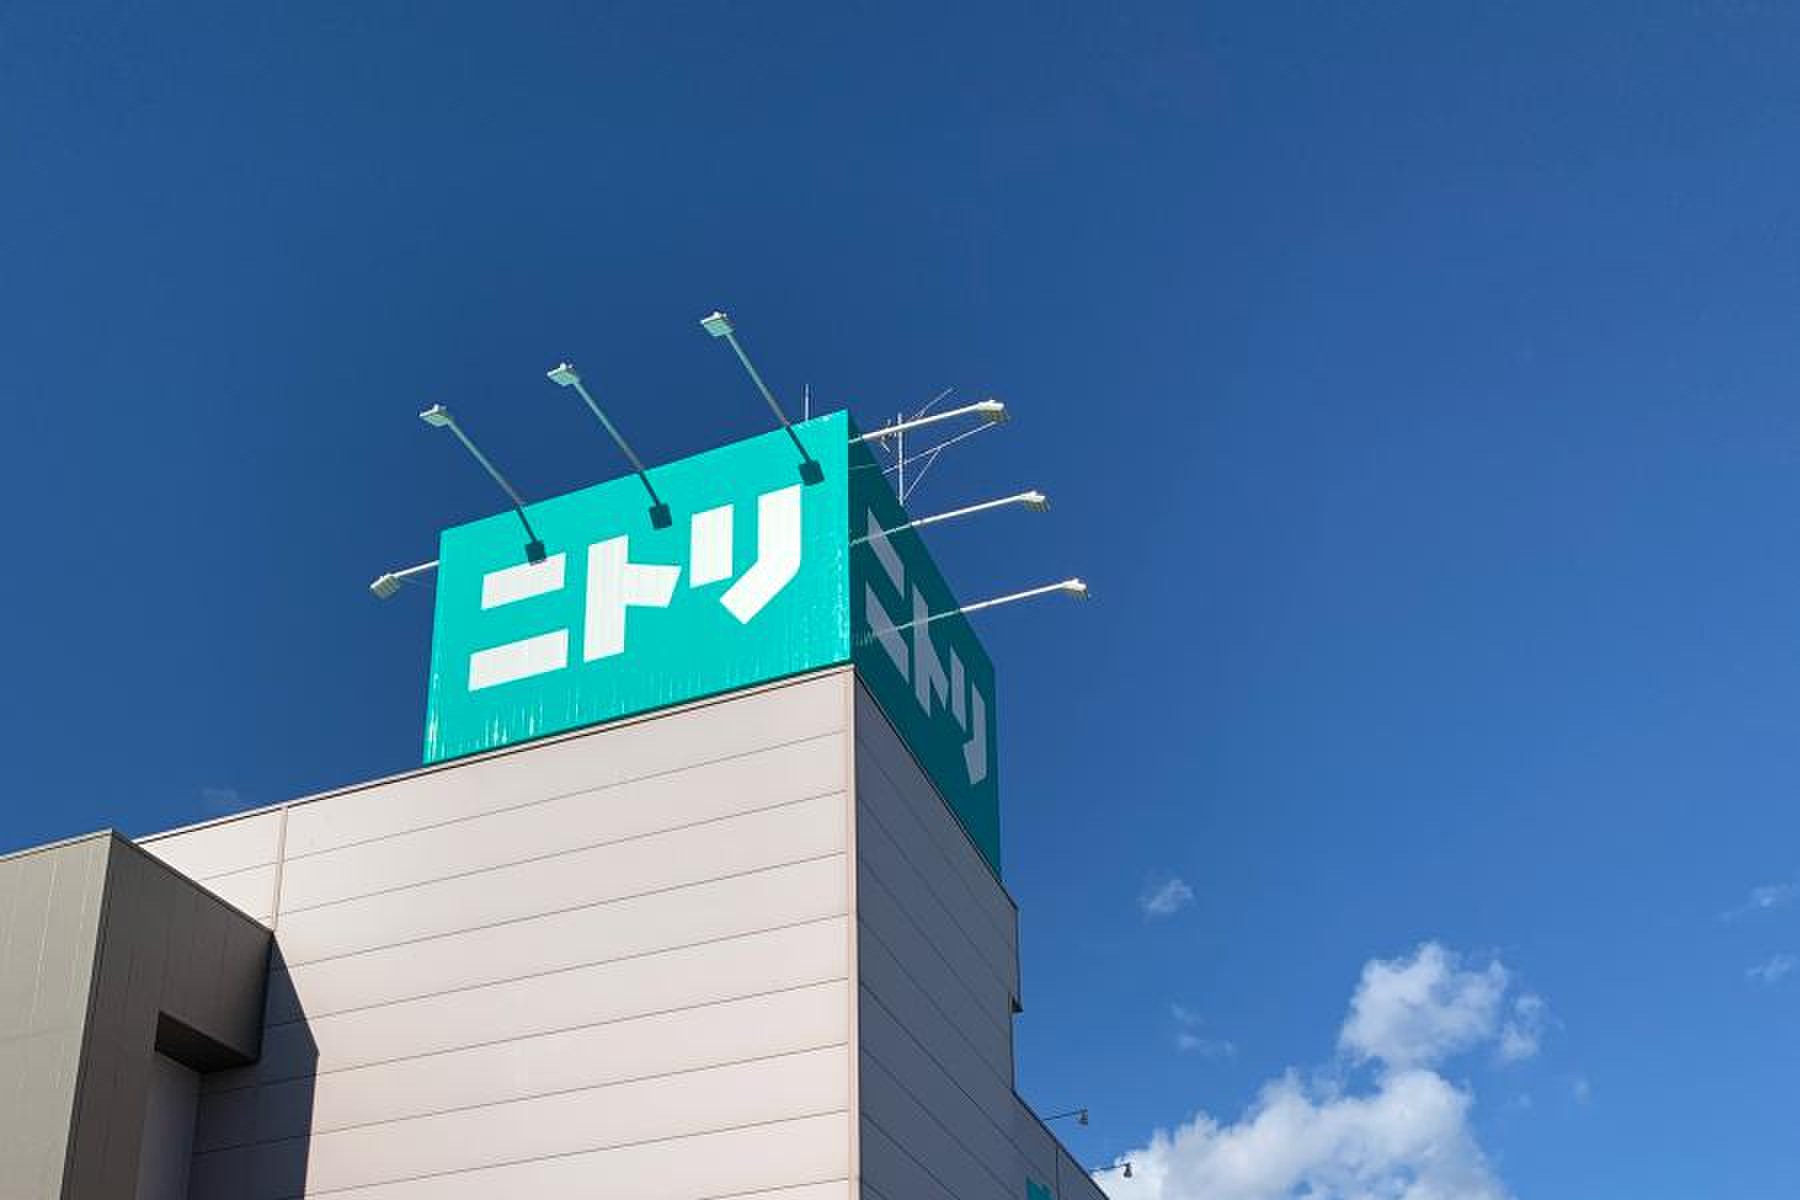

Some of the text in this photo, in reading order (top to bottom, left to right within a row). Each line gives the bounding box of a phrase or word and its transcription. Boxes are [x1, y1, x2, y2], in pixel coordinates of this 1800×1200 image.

[468, 484, 802, 691] ニトリ
[863, 506, 988, 785] ニトリ
